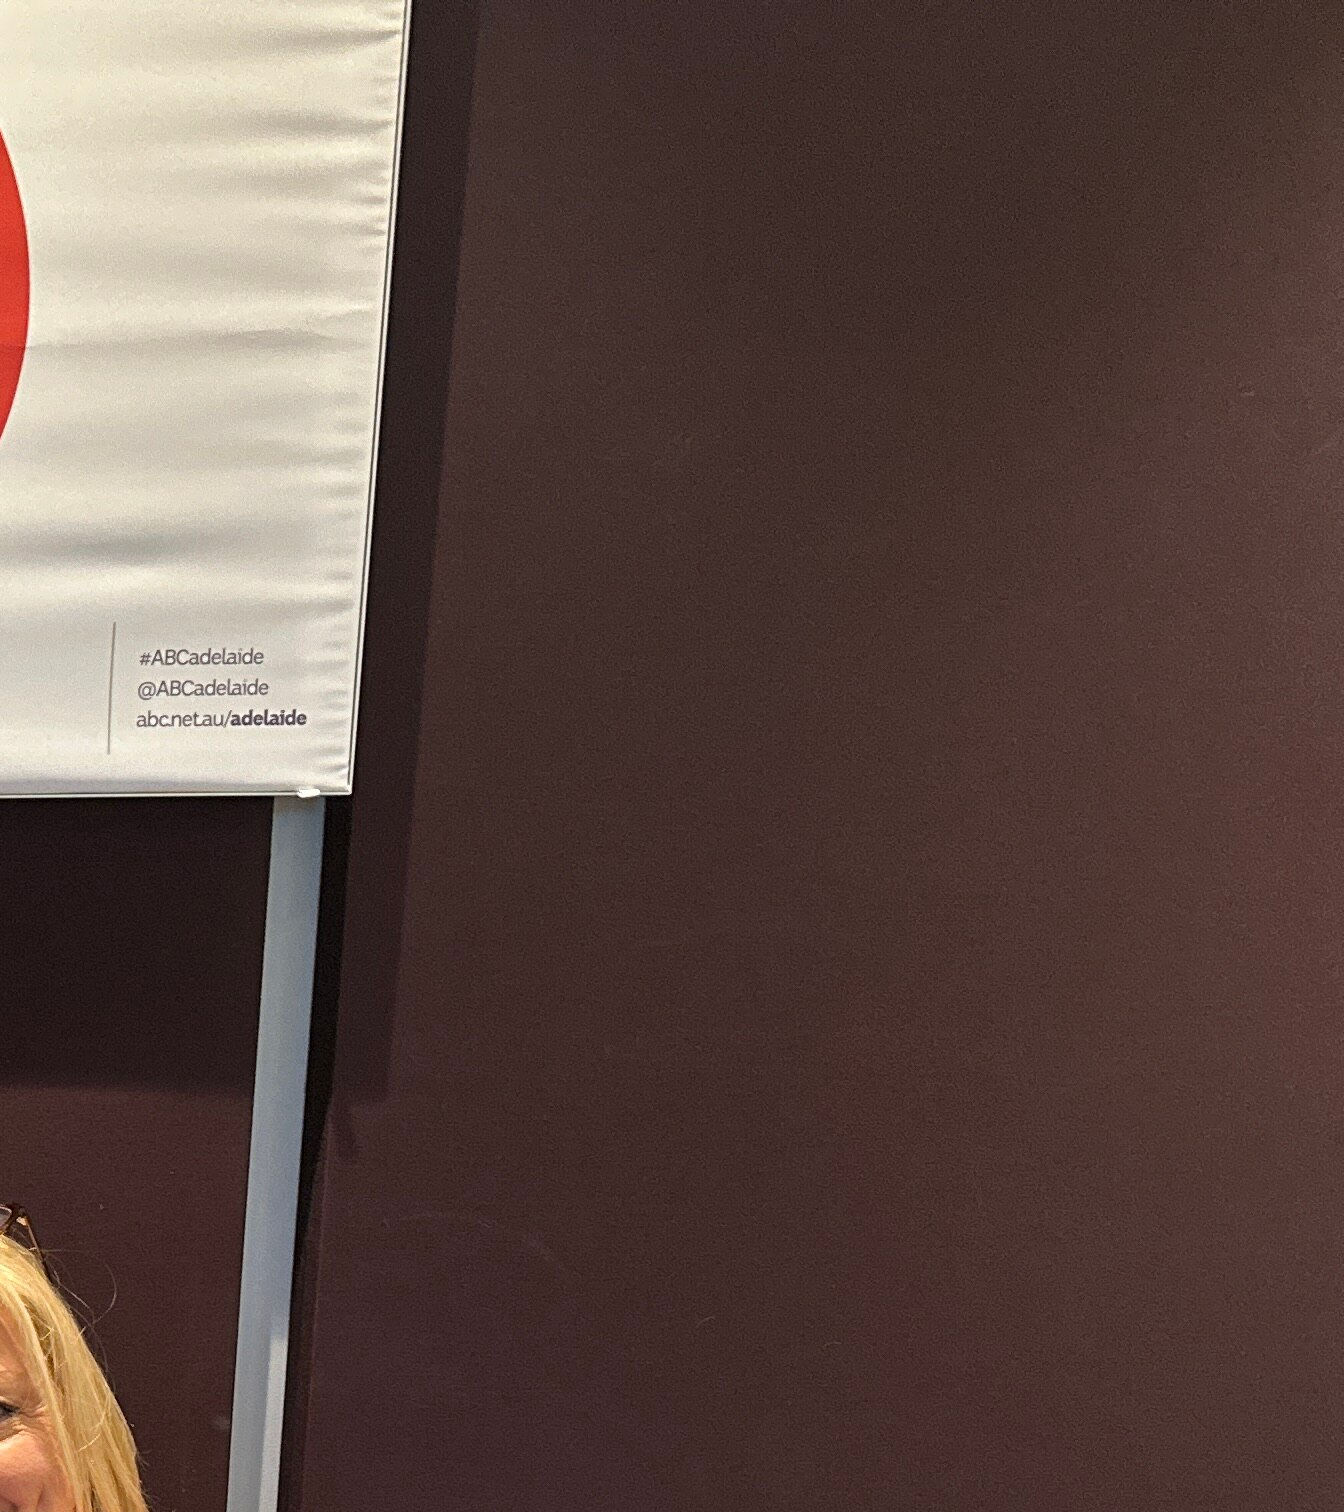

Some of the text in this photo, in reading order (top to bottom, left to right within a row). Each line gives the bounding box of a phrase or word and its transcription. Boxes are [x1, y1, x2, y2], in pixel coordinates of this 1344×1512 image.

[139, 648, 264, 666] #ABCadelaide
[137, 678, 269, 700] @ABCadelaide
[136, 709, 307, 728] abc.net.au/adelaide
